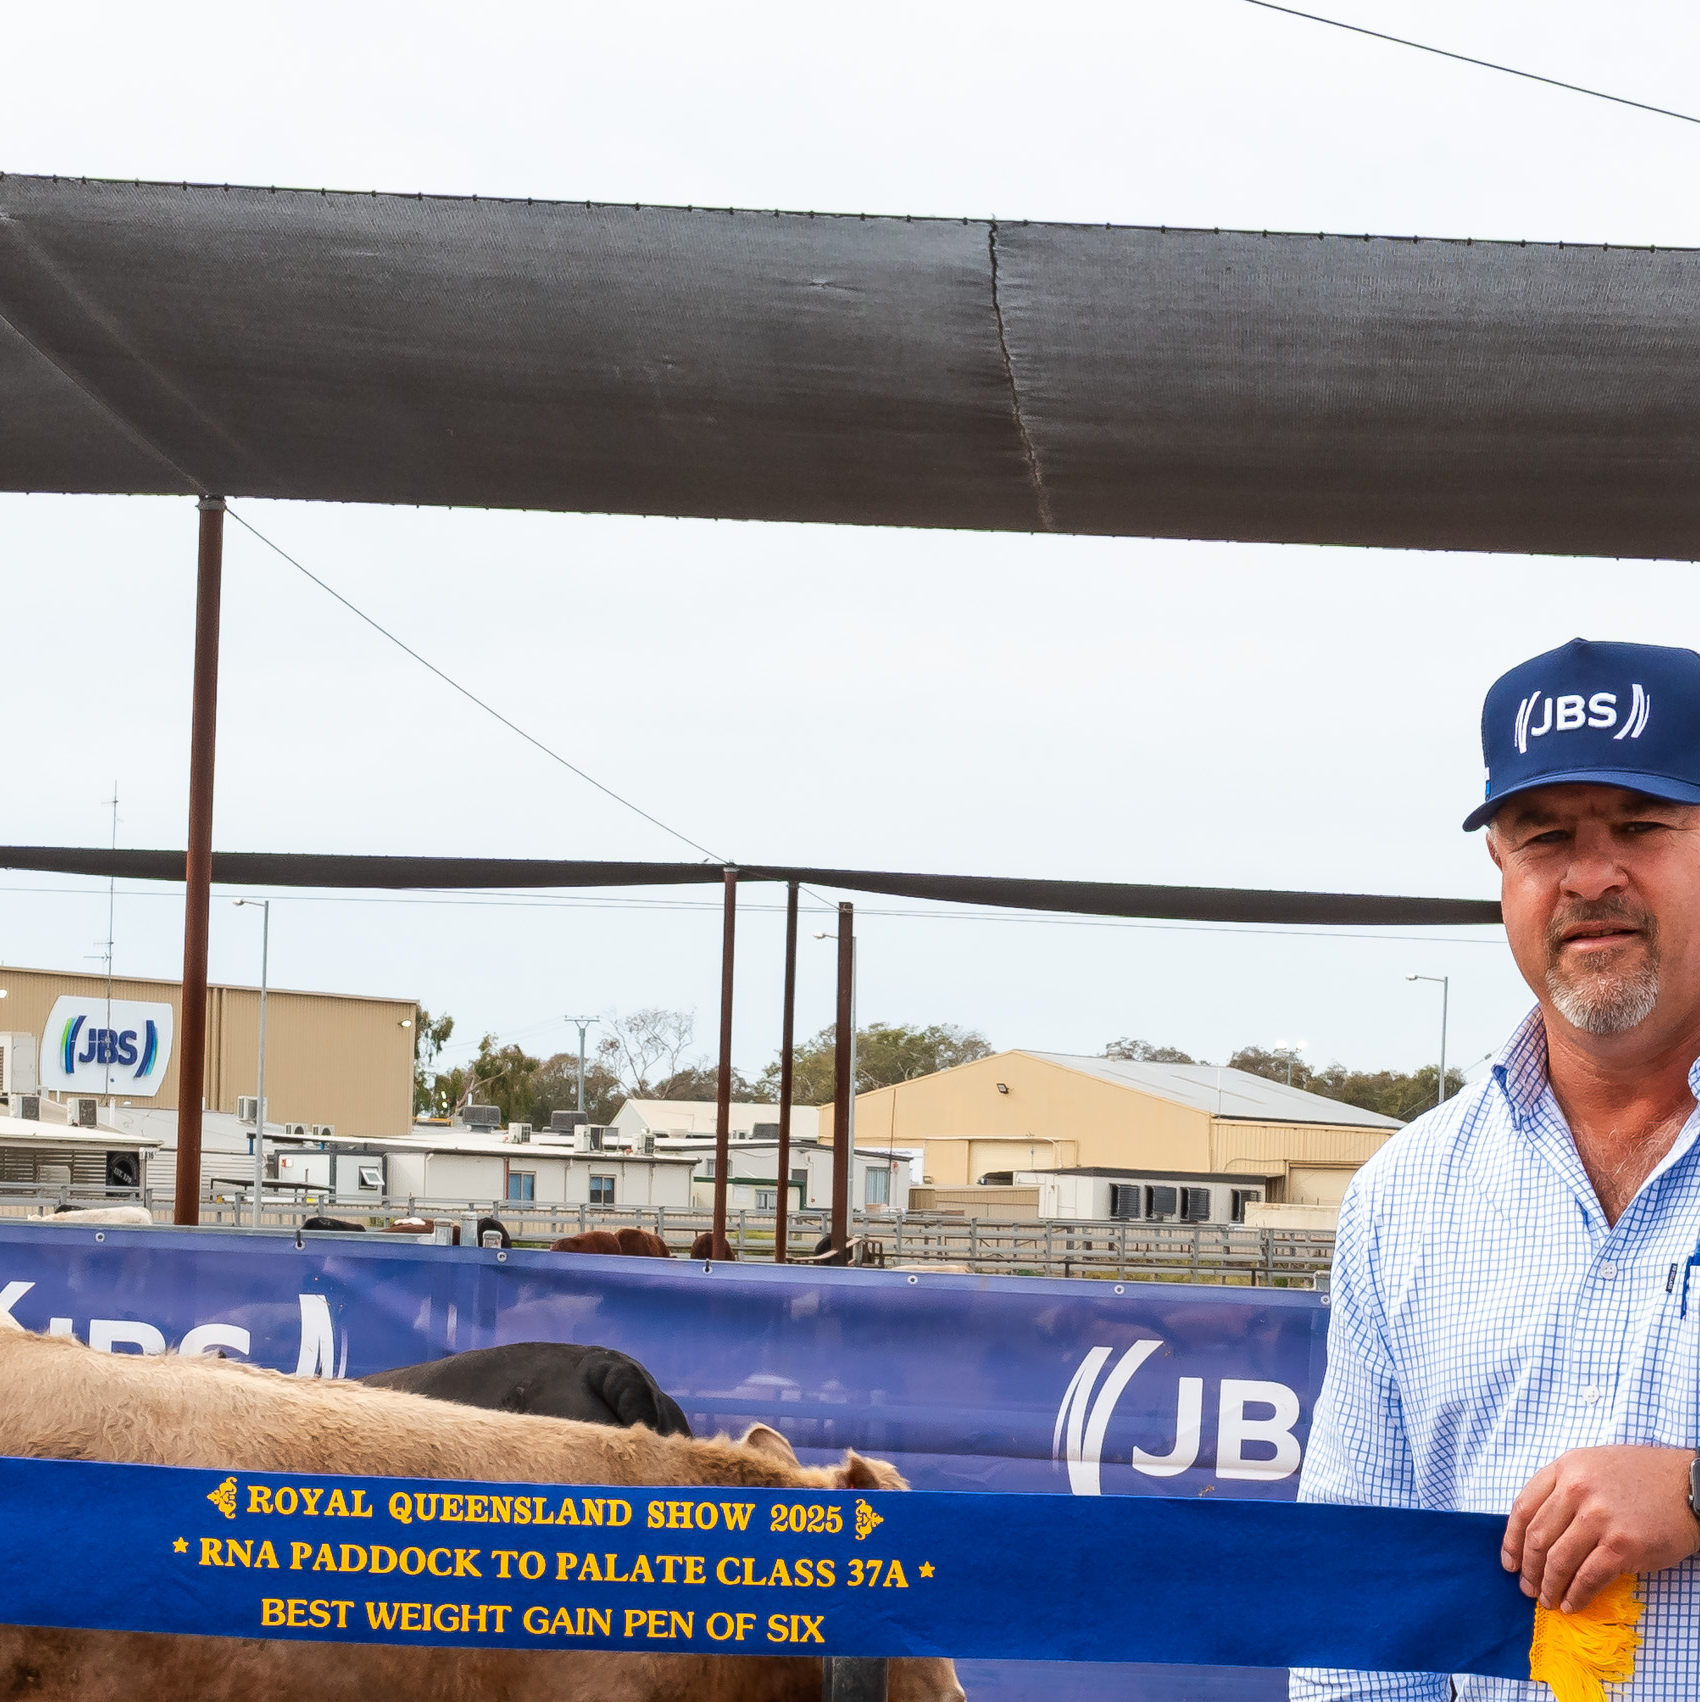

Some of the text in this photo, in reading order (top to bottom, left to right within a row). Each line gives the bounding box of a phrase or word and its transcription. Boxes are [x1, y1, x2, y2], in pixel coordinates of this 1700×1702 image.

[1531, 692, 1617, 737] JBS
[78, 1028, 138, 1066] JBS
[1131, 1377, 1301, 1481] JB
[246, 1485, 844, 1534] ROYAL QUEENSLAND SHOW 2025
[198, 1537, 909, 1589] RNA PADDOCK TO PALATE CLASS 37A
[260, 1598, 826, 1644] BEST WEIGHT GAIN PEN OF SIX
